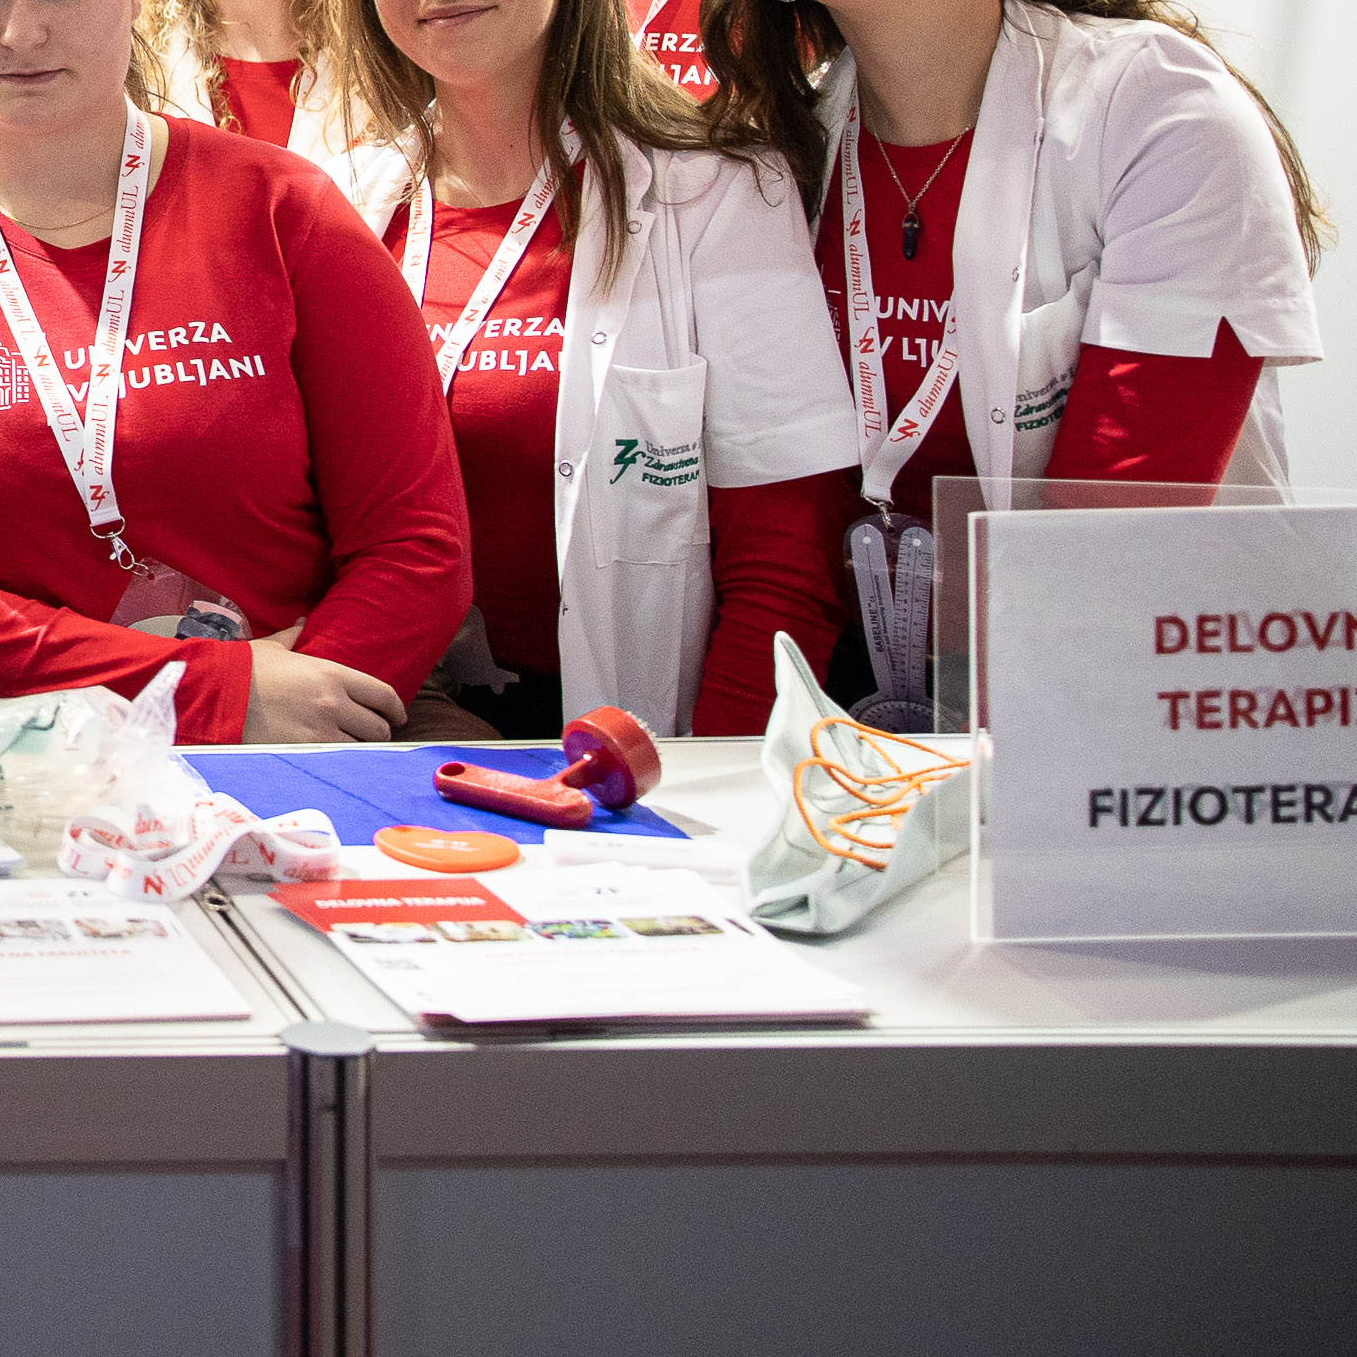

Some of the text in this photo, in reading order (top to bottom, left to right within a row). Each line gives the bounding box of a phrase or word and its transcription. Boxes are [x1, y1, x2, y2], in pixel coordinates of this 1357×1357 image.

[64, 321, 233, 370] UVERZA
[1016, 377, 1059, 402] niverza
[1157, 686, 1357, 731] TERAPI
